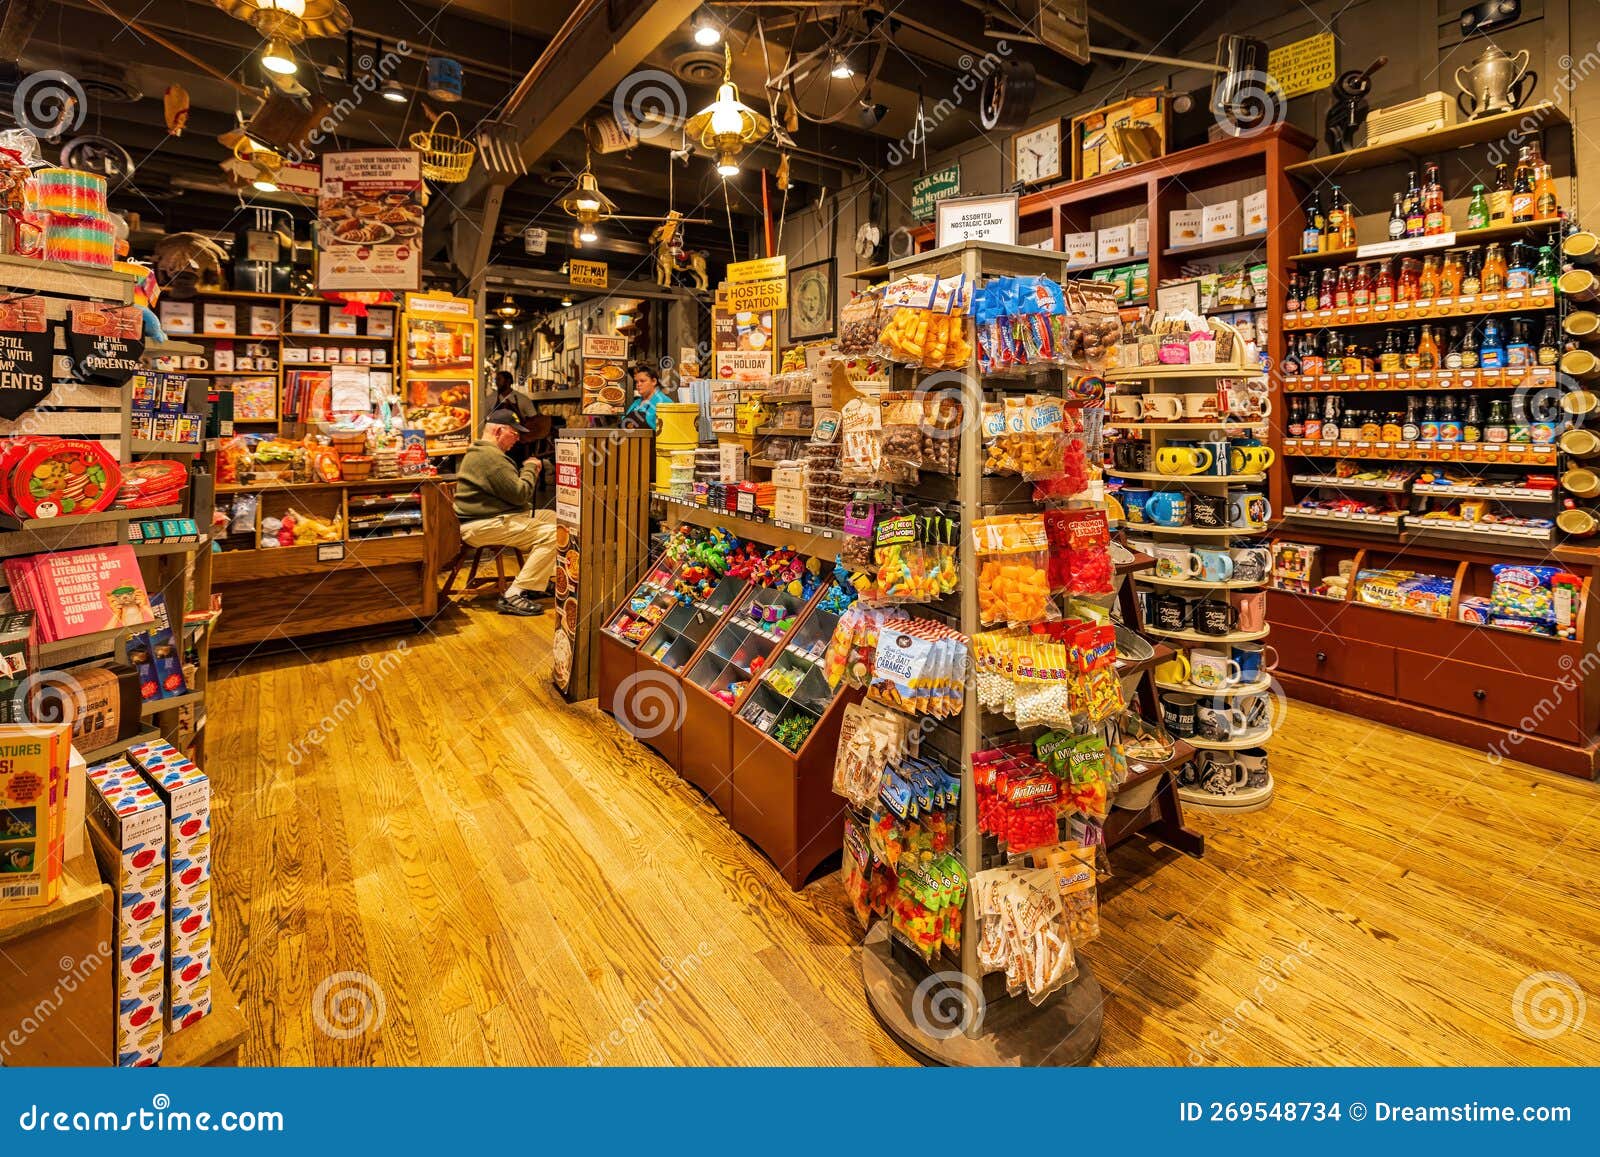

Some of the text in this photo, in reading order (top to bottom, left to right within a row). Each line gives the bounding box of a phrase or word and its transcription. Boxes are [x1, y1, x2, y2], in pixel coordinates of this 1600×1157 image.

[913, 171, 956, 195] FOR SALE
[951, 217, 1003, 229] NOSTALGIC CANDY
[961, 213, 992, 221] ASSORTED
[963, 230, 969, 239] 3
[572, 264, 607, 278] RITE-WAY
[731, 282, 783, 299] HOSTESS
[735, 296, 779, 311] STATION
[93, 342, 128, 352] LIVE WITH
[7, 349, 33, 362] WITH
[86, 356, 136, 370] PARENTS
[733, 359, 766, 369] HOLIDAY
[1, 372, 43, 391] ENTS
[49, 552, 108, 567] THIS BOOK IS
[51, 560, 121, 577] LITERALLY JUST
[54, 570, 111, 586] PICTURES OF
[57, 582, 100, 596] ANIMALS
[60, 591, 101, 605] SILENTLY
[63, 601, 104, 615] JUDGING
[64, 613, 85, 625] YOU
[884, 650, 911, 666] SEA SALT
[876, 656, 912, 679] CARAMELS
[1013, 786, 1025, 799] HOT
